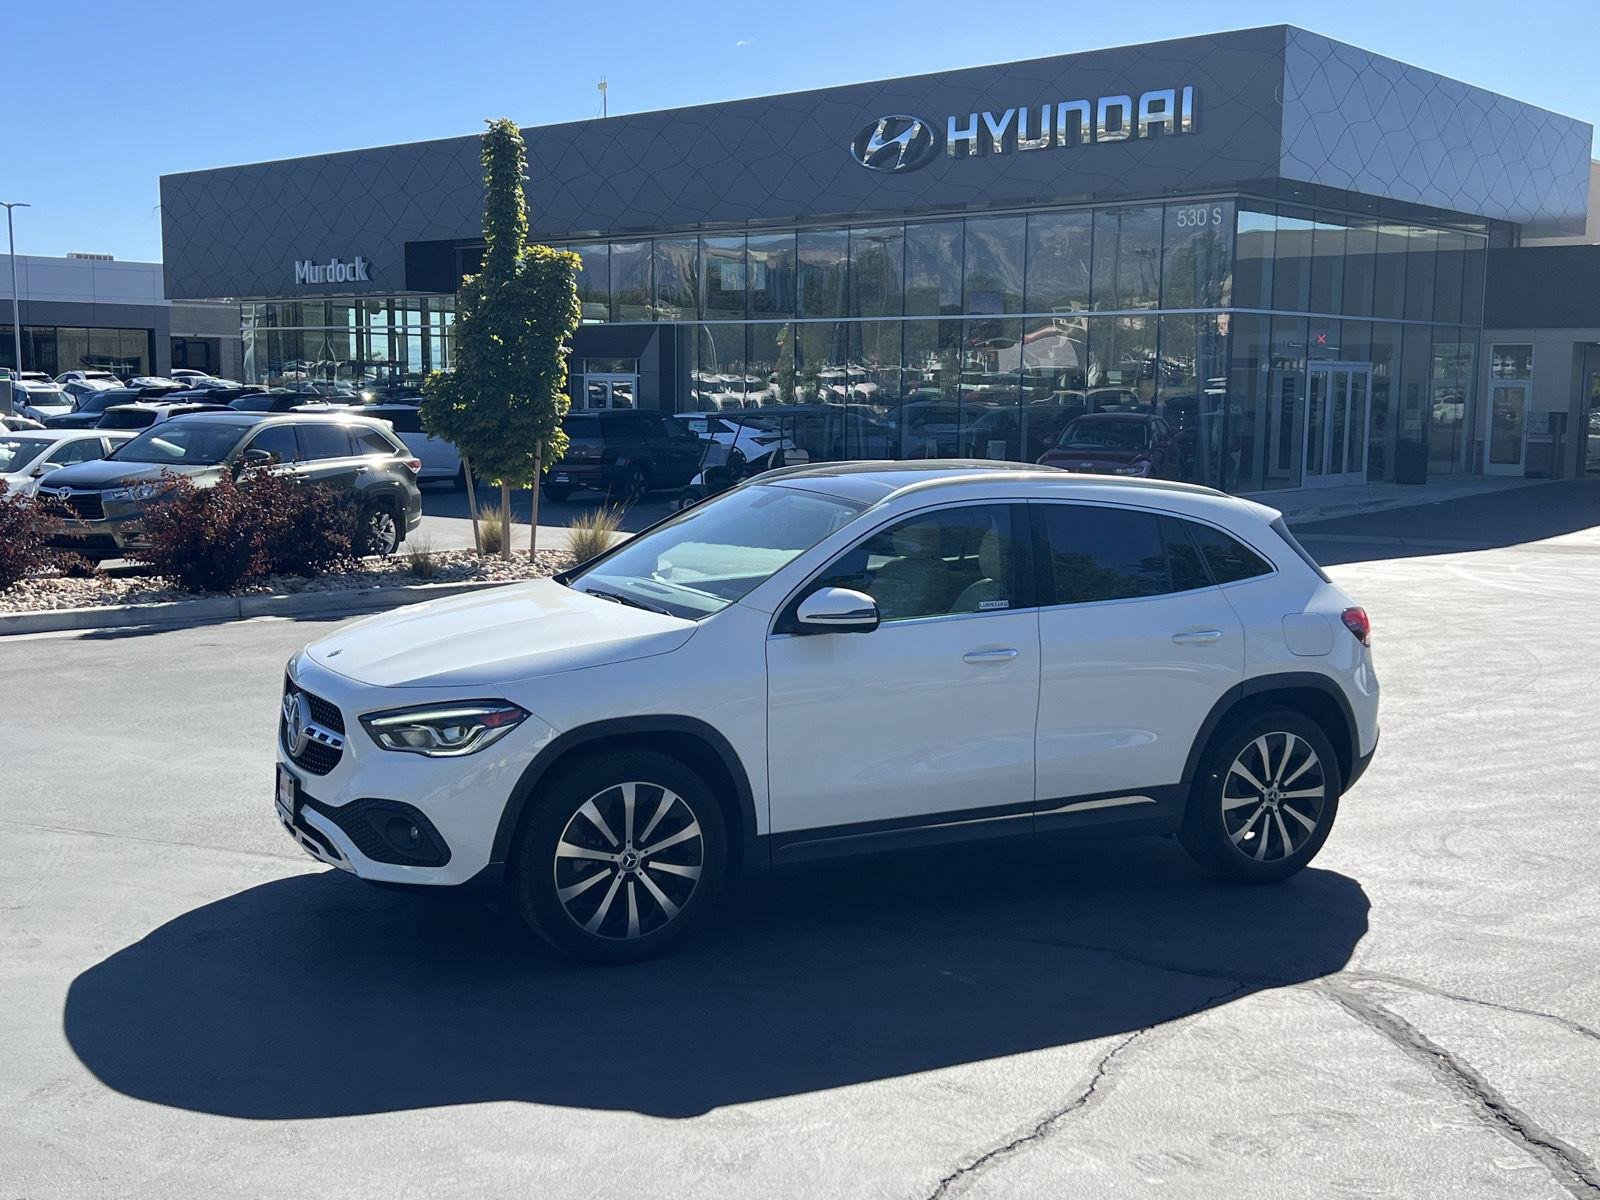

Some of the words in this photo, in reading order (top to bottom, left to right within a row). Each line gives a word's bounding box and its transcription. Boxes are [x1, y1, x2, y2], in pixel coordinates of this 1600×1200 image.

[946, 86, 1194, 159] HYUNDAI
[1177, 208, 1207, 227] 530
[1211, 207, 1222, 225] S
[294, 256, 369, 284] Murdock
